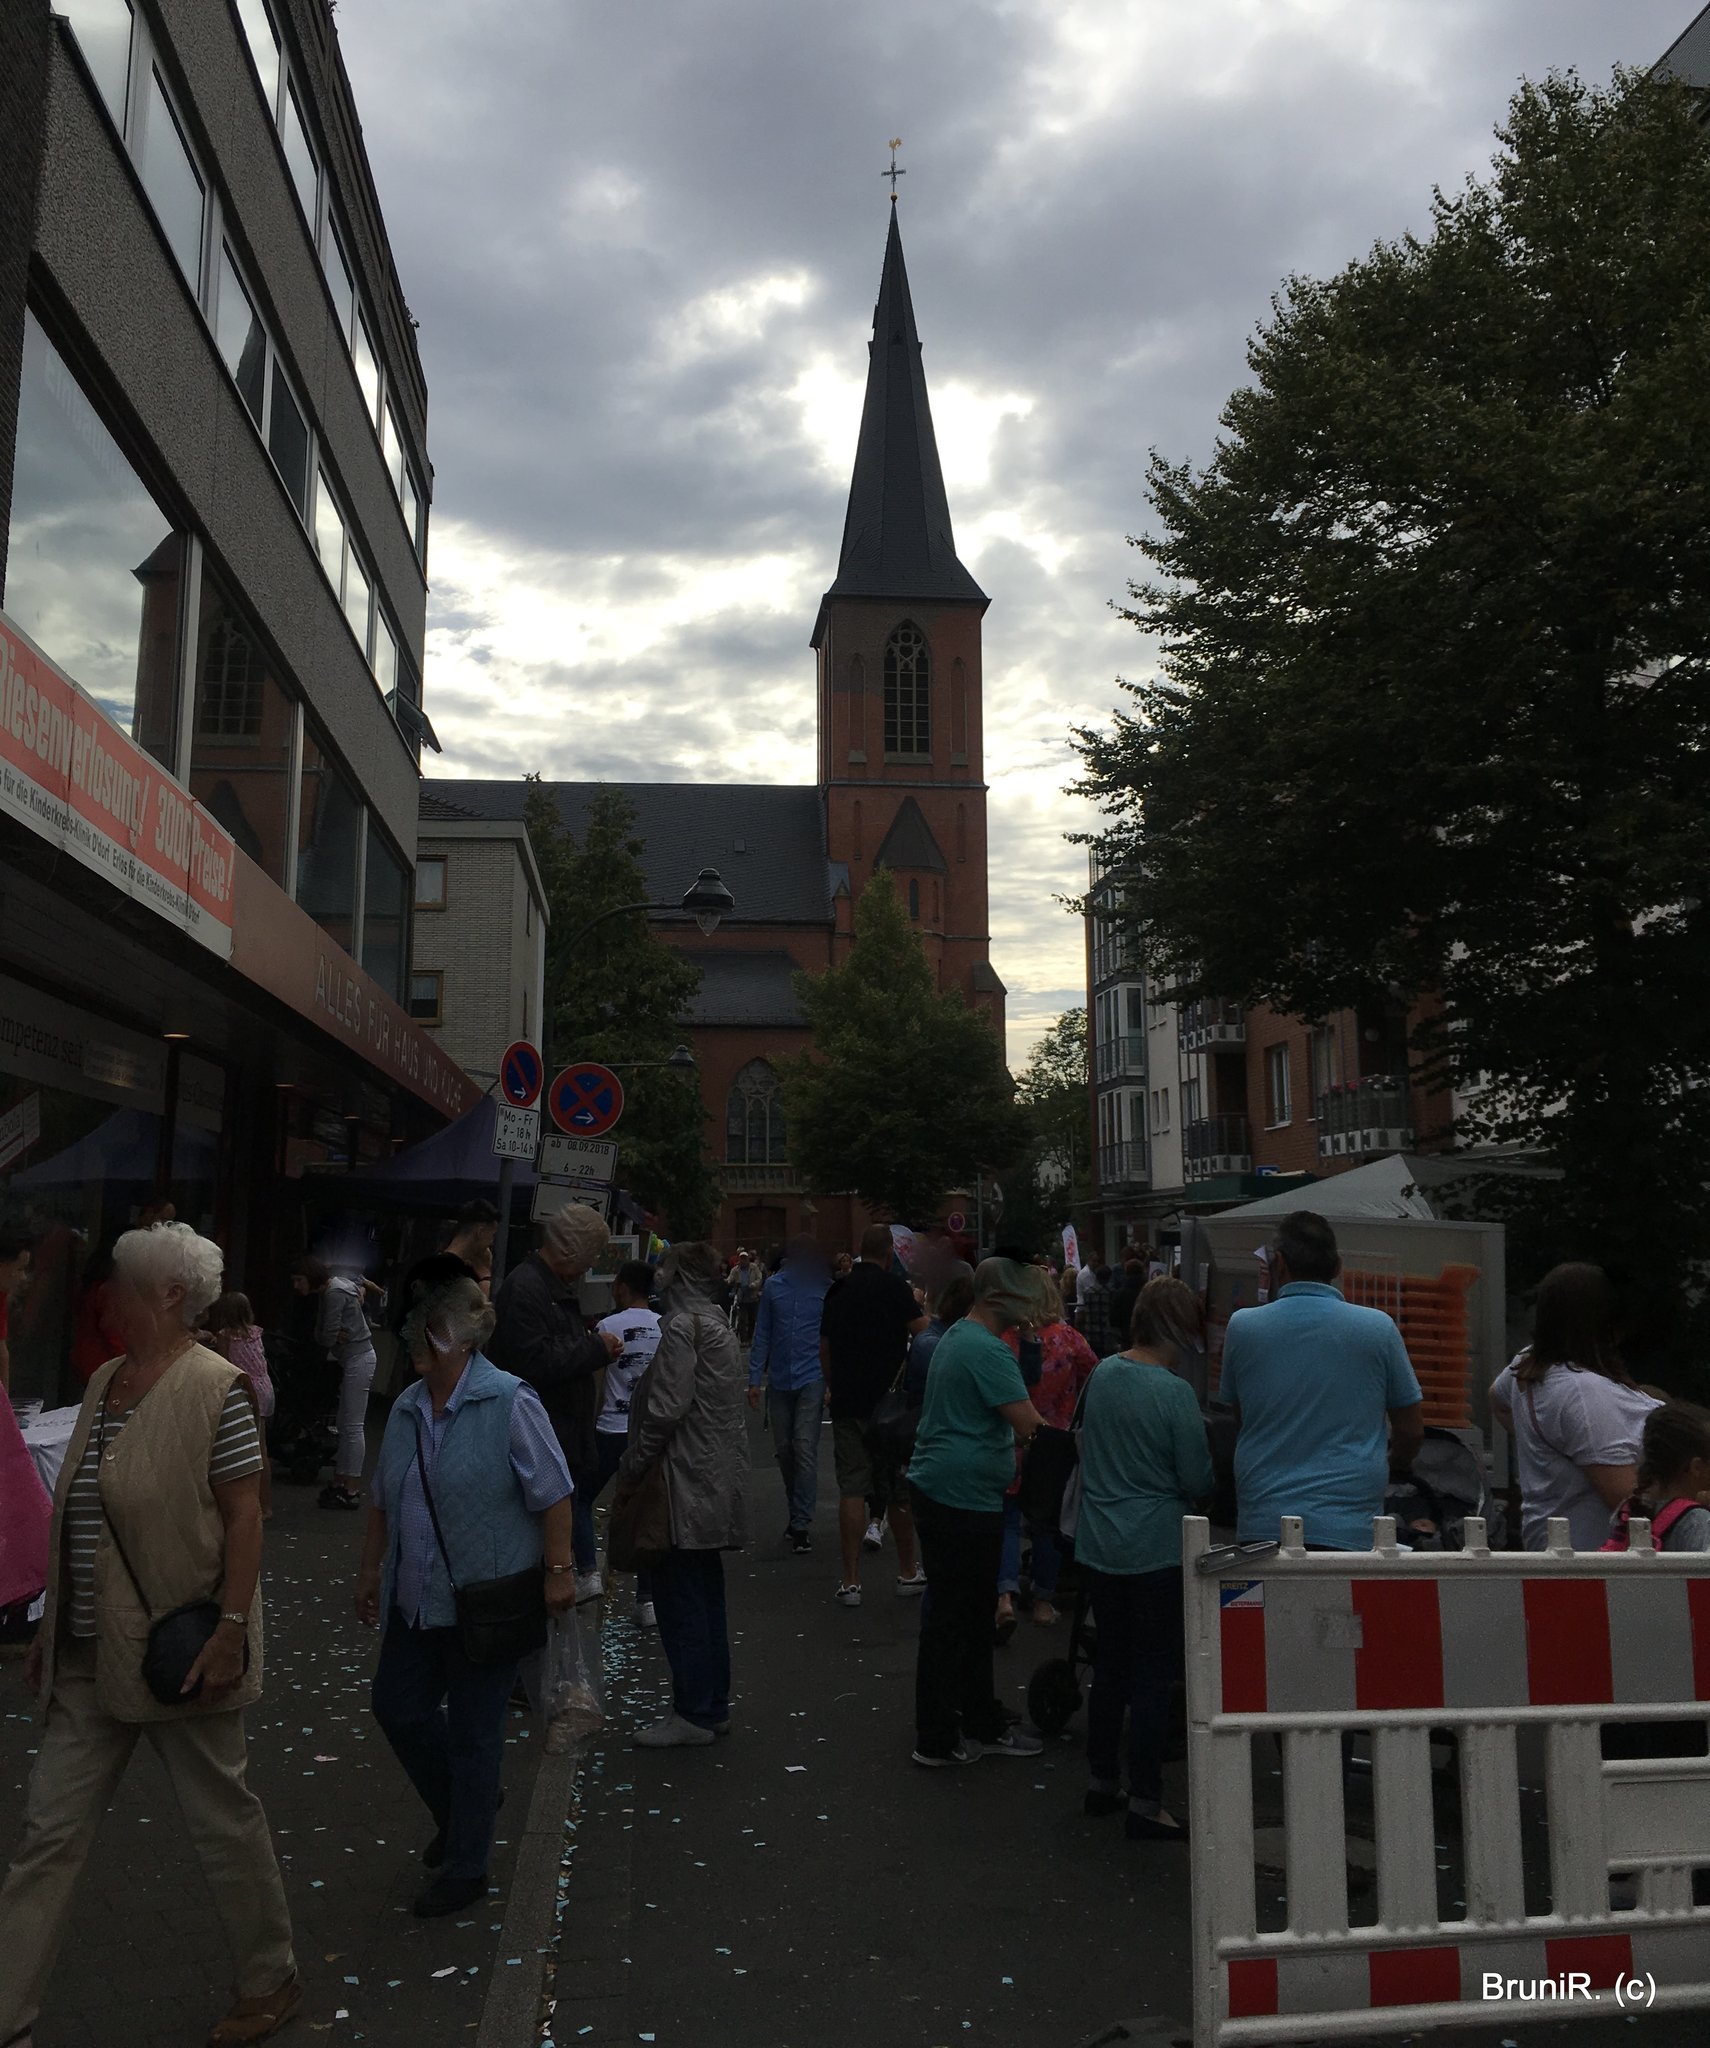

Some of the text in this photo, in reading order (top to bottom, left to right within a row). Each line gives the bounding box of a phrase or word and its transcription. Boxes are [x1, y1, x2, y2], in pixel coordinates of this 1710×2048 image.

[4, 767, 16, 796] für
[17, 778, 28, 805] die
[191, 815, 236, 902] Preise!
[315, 954, 361, 1036] ALLES
[394, 1023, 419, 1080] HAUS
[504, 1110, 516, 1123] Mo
[524, 1114, 533, 1126] Fr
[503, 1124, 508, 1136] 9
[516, 1127, 524, 1139] 18
[496, 1138, 506, 1150] Sa
[551, 1139, 610, 1155] ab 08.09.2018
[564, 1163, 569, 1173] 6
